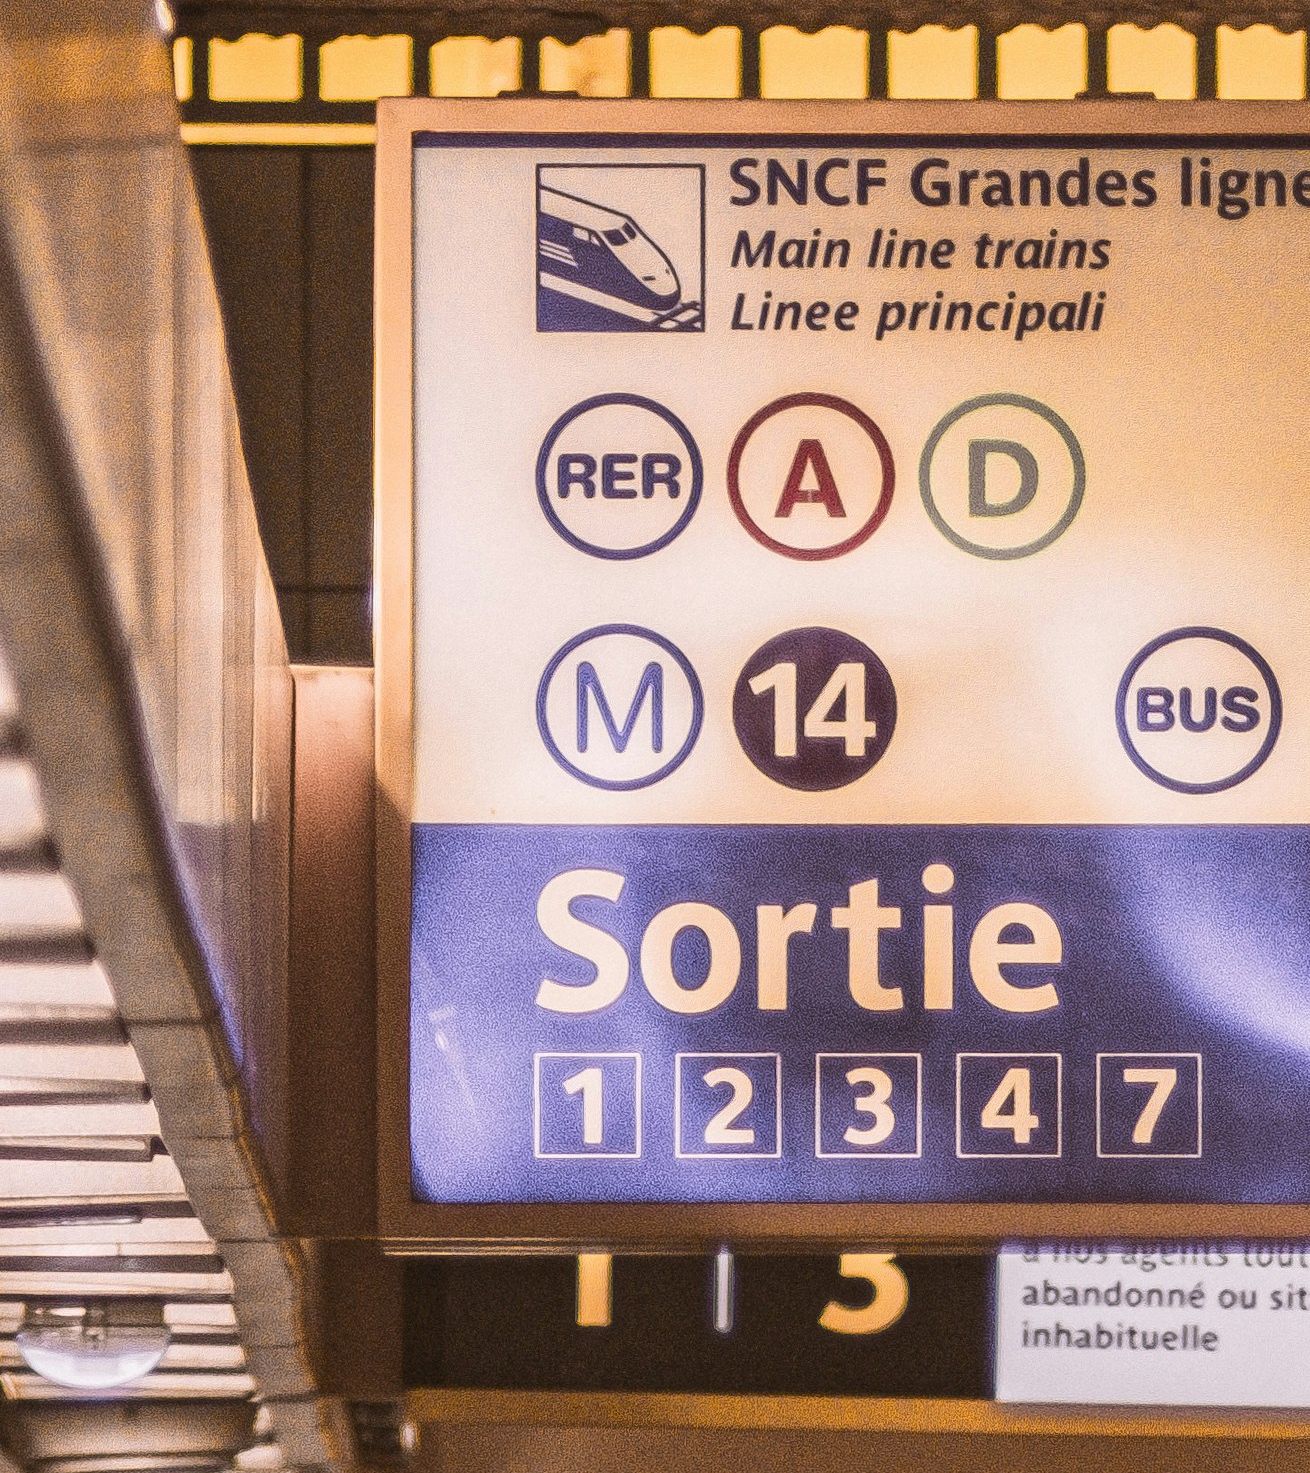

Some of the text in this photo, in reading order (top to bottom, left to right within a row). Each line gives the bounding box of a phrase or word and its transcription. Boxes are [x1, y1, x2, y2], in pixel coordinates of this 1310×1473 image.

[731, 158, 887, 207] SNCF
[910, 157, 1158, 208] Grandes
[732, 229, 1110, 270] Main line trains
[731, 292, 1106, 341] Linee principali
[557, 438, 1039, 518] RER A D
[576, 661, 878, 758] M 14
[1138, 686, 1260, 733] BUS
[535, 864, 1062, 1013] Sortie
[563, 1067, 1177, 1146] 1 2 3 4 7
[1022, 1280, 1205, 1309] abandonné
[1218, 1288, 1258, 1310] ou
[1022, 1322, 1219, 1352] inhabituelle
